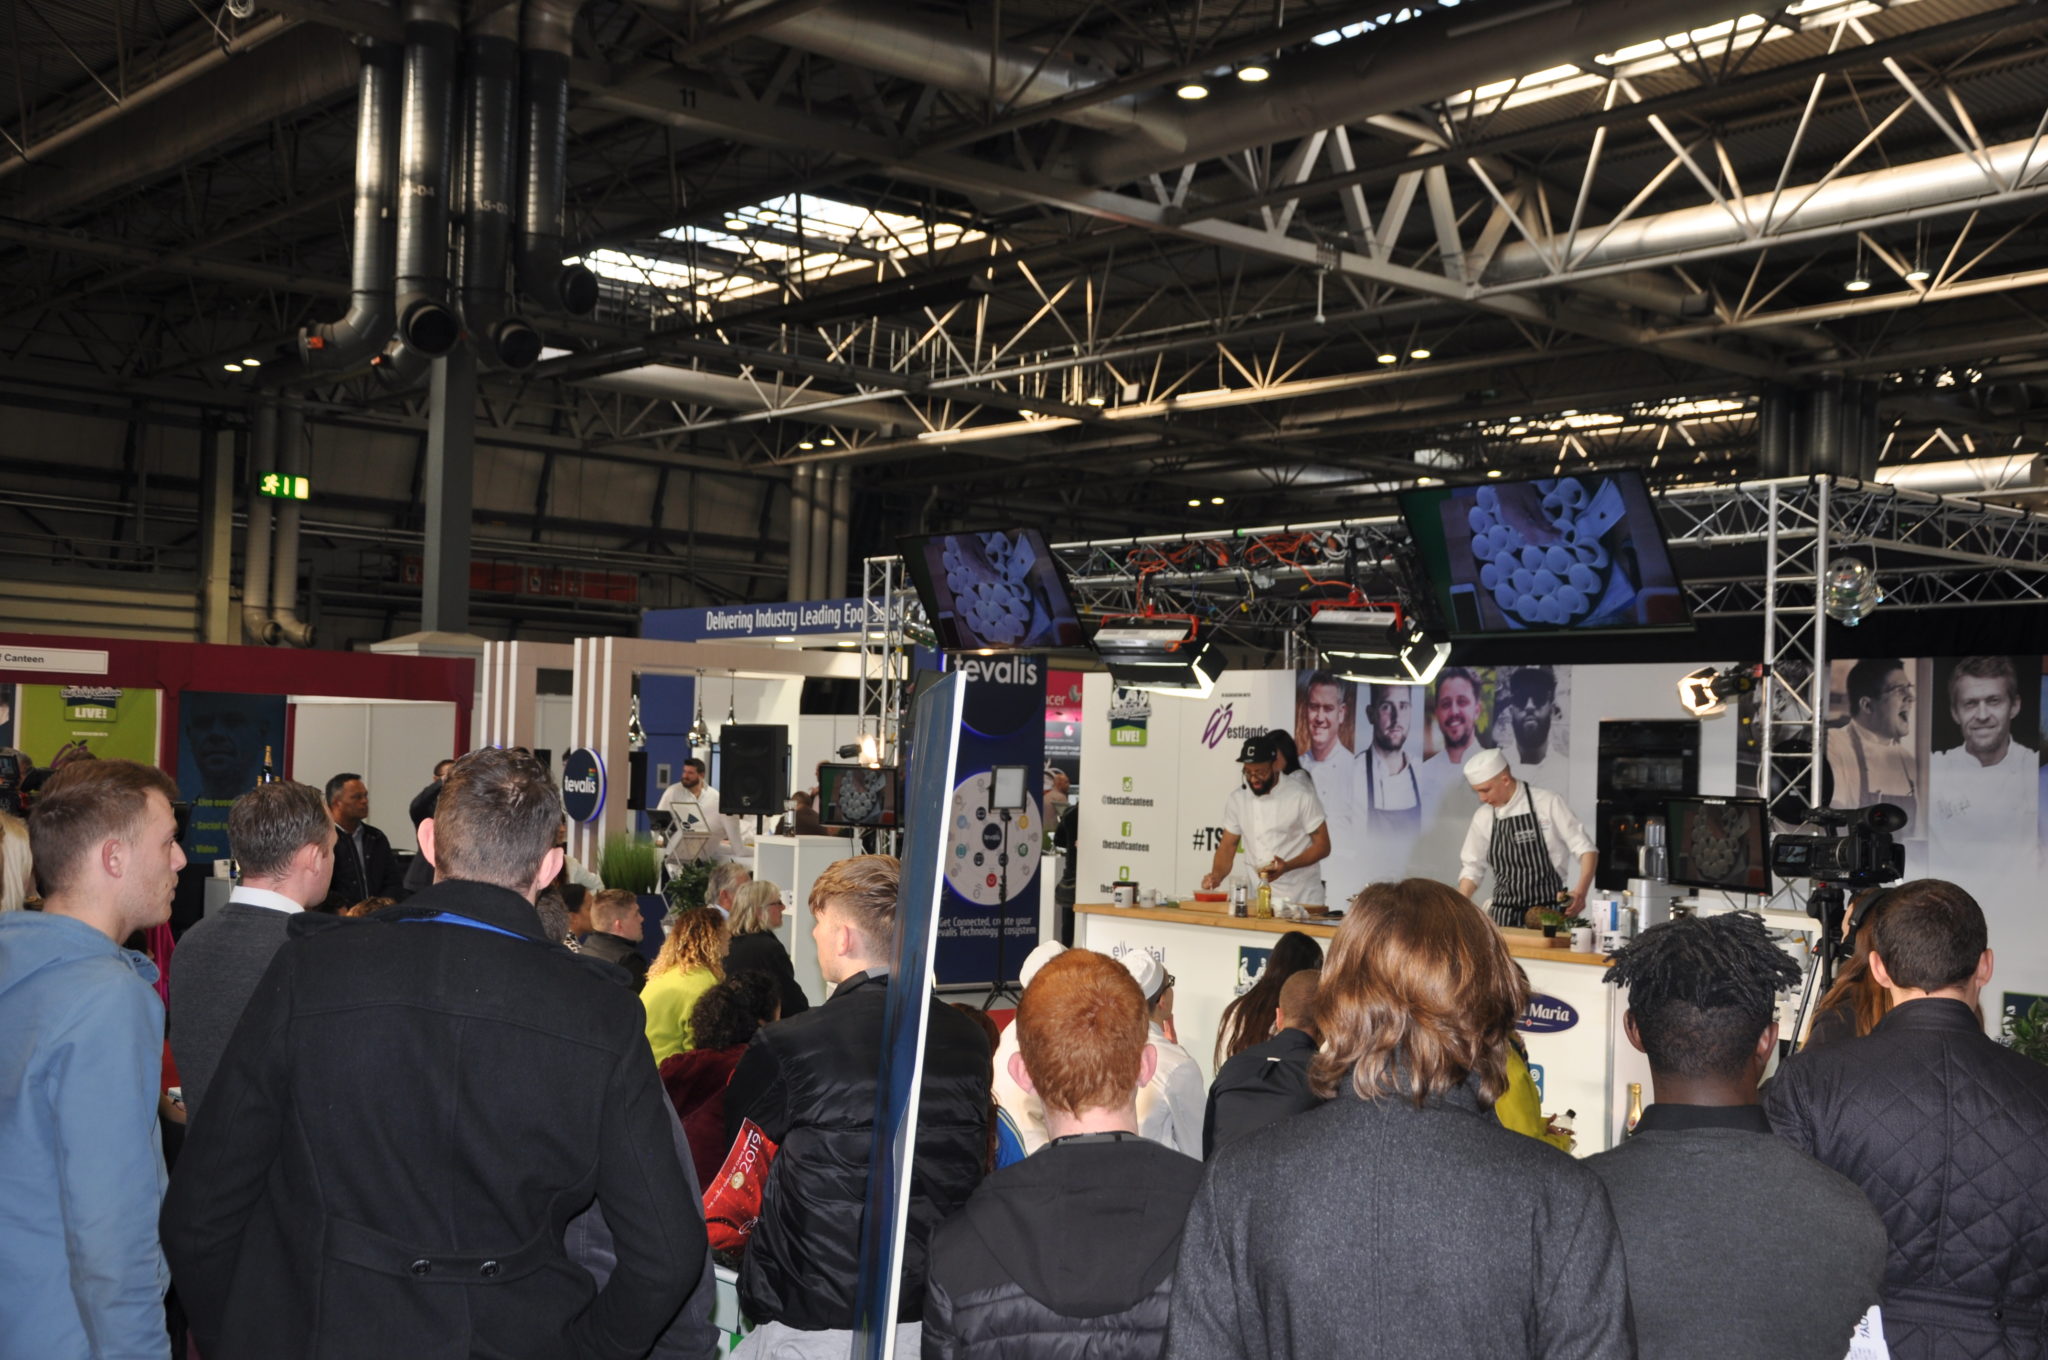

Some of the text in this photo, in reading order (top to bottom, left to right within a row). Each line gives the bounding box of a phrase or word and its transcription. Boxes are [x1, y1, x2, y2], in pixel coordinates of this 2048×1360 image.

[706, 611, 753, 634] Delivering
[755, 608, 798, 632] Industry
[800, 606, 841, 630] Leading
[844, 603, 865, 628] Epo
[4, 653, 45, 664] Canteen
[953, 653, 1038, 686] tevalis
[74, 707, 107, 719] LIVE!
[1116, 730, 1140, 743] LIVE!
[1201, 707, 1269, 749] Westlands
[1246, 746, 1256, 757] C
[564, 776, 597, 794] tevalis
[937, 926, 958, 937] evalis
[1004, 926, 1036, 937] cosystem
[1529, 1003, 1570, 1022] Maria
[740, 1132, 762, 1173] 2019
